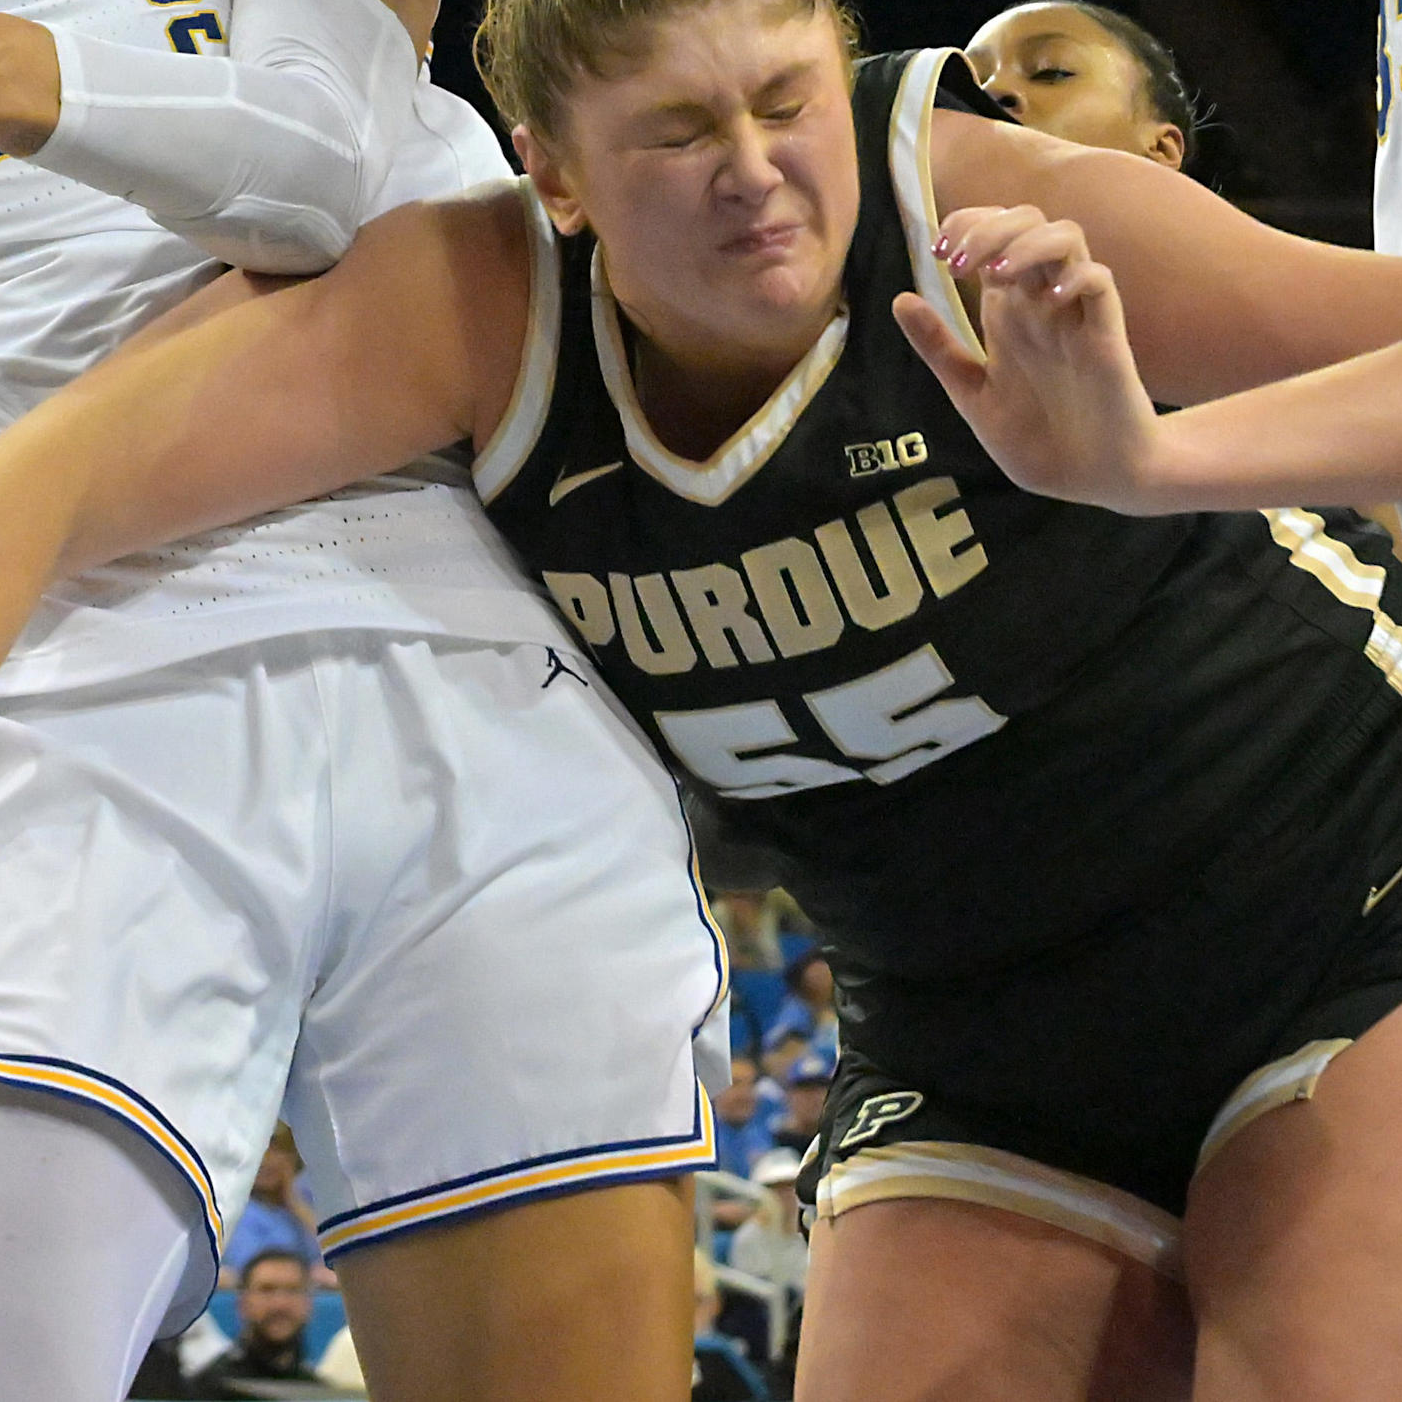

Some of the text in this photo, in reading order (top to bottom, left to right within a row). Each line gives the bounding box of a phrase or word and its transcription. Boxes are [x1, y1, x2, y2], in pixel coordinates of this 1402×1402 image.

[542, 475, 989, 676] PURDUE
[653, 642, 1009, 798] 55
[839, 1091, 924, 1150] P
